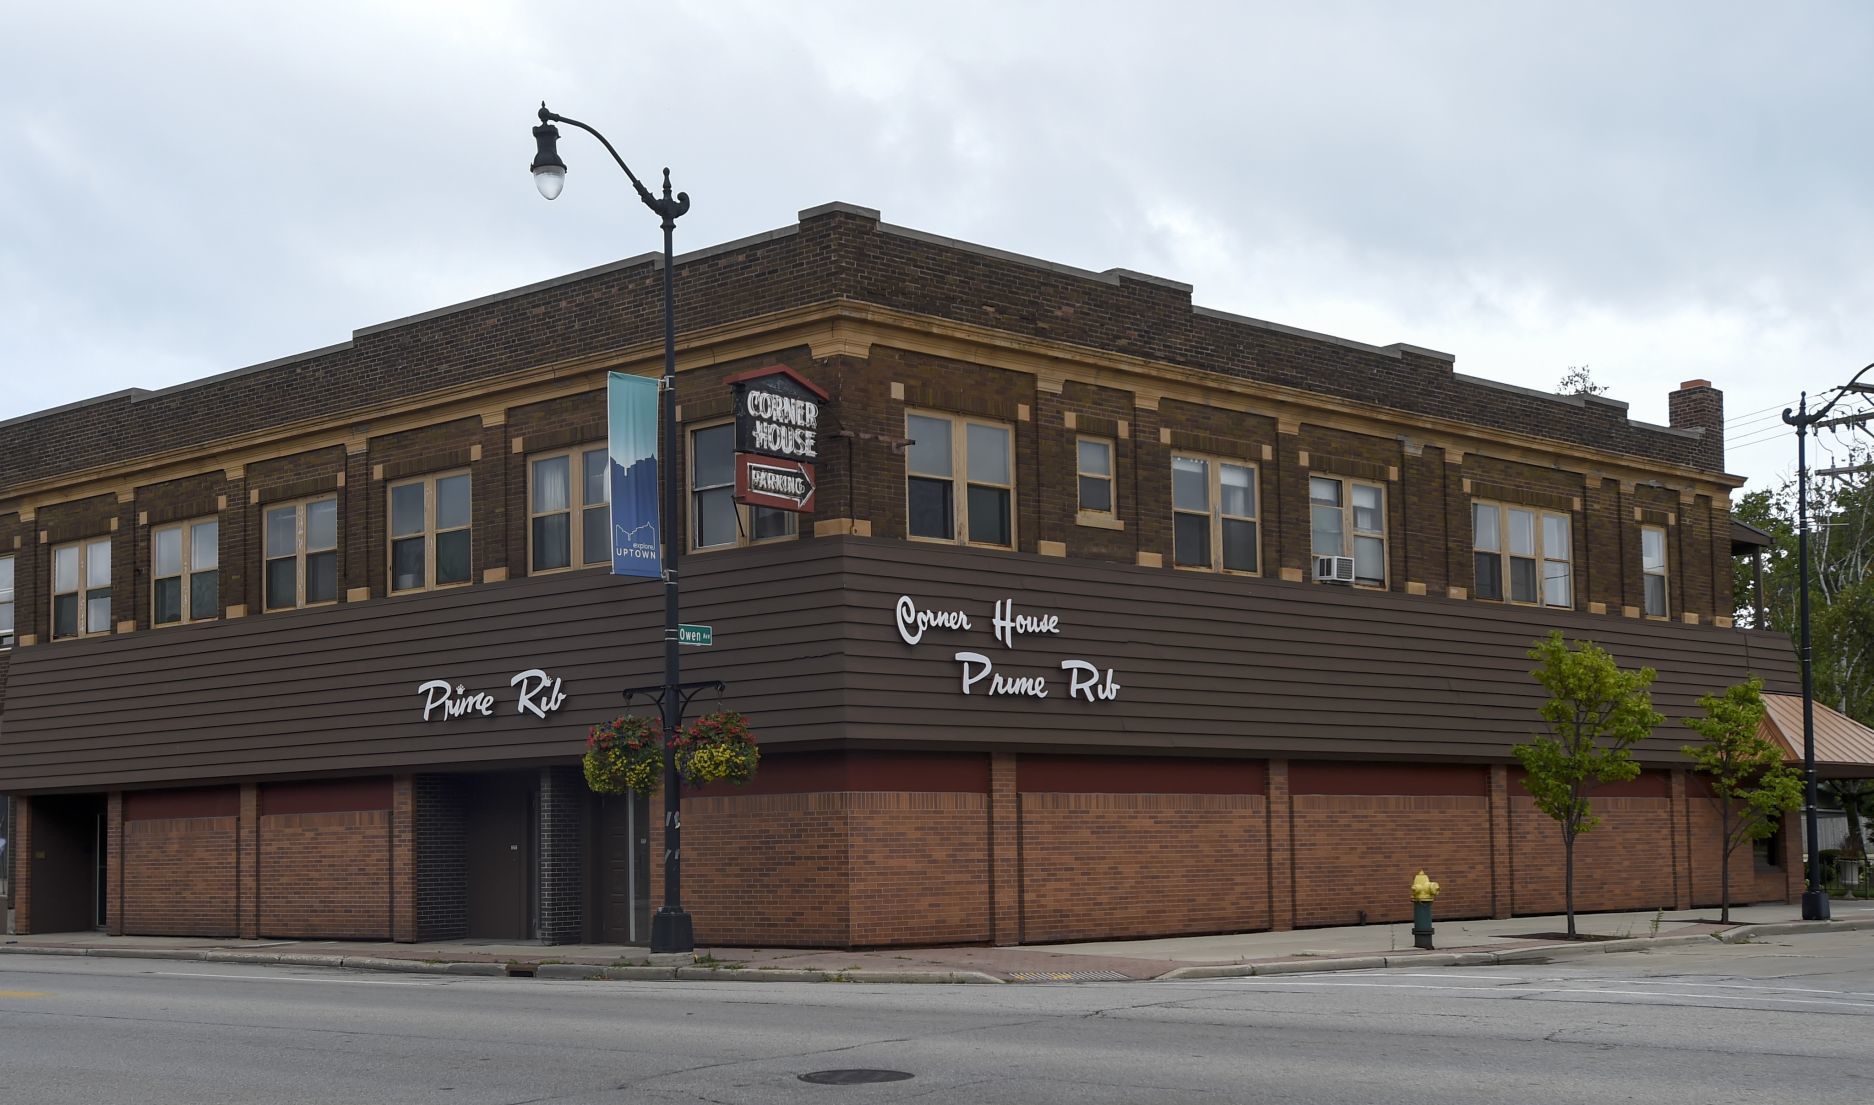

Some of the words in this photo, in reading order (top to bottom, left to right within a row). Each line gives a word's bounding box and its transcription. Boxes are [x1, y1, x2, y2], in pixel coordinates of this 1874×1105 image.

[747, 390, 818, 429] CORNER
[752, 420, 818, 457] HOUSE
[752, 469, 805, 495] PARKING
[616, 547, 656, 560] UPTOWN
[632, 542, 655, 551] explore
[679, 628, 701, 641] Owen
[896, 595, 972, 645] Corner
[992, 598, 1060, 648] House
[418, 679, 494, 722] Prime
[510, 668, 566, 719] Rib
[955, 651, 1048, 698] Prime
[1061, 659, 1121, 702] Rib
